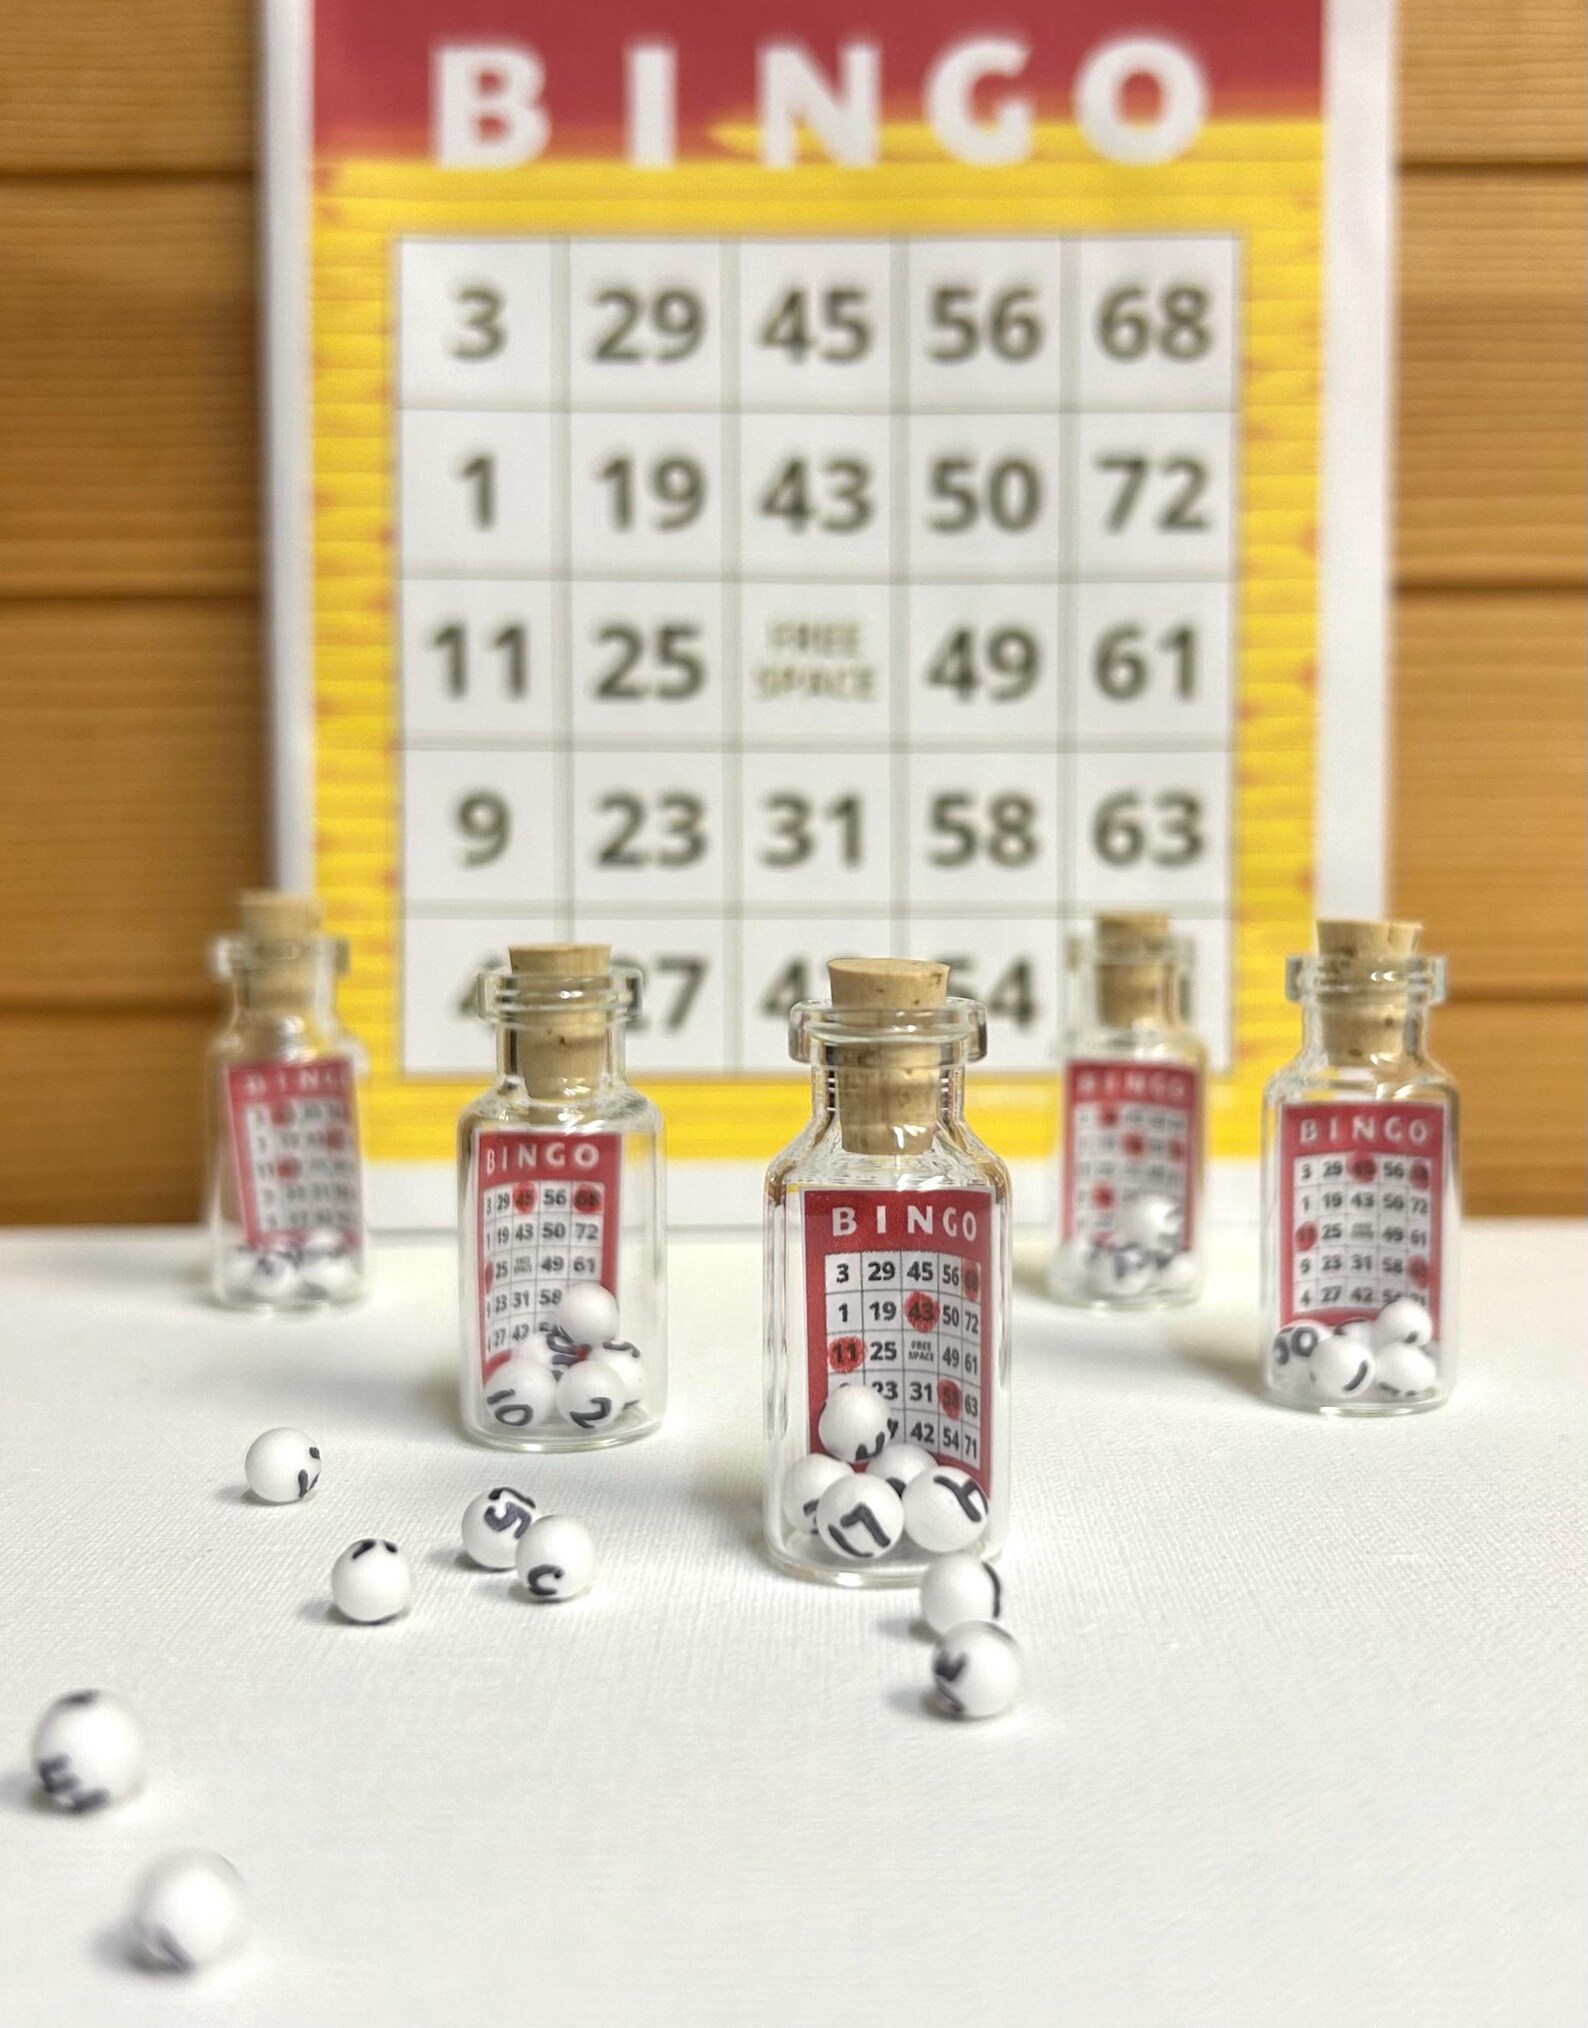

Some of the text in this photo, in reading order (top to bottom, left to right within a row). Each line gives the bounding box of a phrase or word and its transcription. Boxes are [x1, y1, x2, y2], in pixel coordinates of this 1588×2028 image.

[432, 37, 1210, 170] BINGO
[450, 279, 1214, 366] 3 29 45 56 68
[457, 449, 1211, 536] 1 19 43 50 72
[766, 618, 860, 659] FREE
[429, 619, 1198, 703] 11 25 49 61
[752, 664, 877, 702] SPACE
[452, 786, 1207, 870] 9 23 31 58 63
[1299, 1116, 1428, 1145] BINGO
[486, 1142, 600, 1175] BINGO
[1301, 1163, 1311, 1179] 3
[1383, 1162, 1404, 1178] 56
[497, 1192, 510, 1211] 29
[544, 1188, 566, 1206] 56
[1302, 1196, 1310, 1211] 1
[1321, 1193, 1342, 1209] 19
[1350, 1193, 1374, 1208] 43
[1410, 1197, 1428, 1214] 72
[496, 1226, 510, 1244] 19
[515, 1223, 534, 1240] 43
[542, 1223, 566, 1239] 50
[575, 1223, 599, 1239] 72
[832, 1204, 978, 1242] BINGO
[1321, 1223, 1342, 1239] 25
[1381, 1225, 1403, 1241] 49
[1410, 1229, 1427, 1245] 61
[495, 1261, 508, 1279] 25
[541, 1256, 564, 1273] 49
[573, 1257, 597, 1273] 61
[835, 1263, 850, 1284] 3
[867, 1261, 897, 1281] 29
[906, 1261, 934, 1282] 45
[942, 1264, 960, 1287] 56
[1300, 1258, 1310, 1273] 9
[1321, 1256, 1342, 1272] 23
[1351, 1255, 1371, 1271] 31
[1382, 1257, 1403, 1273] 58
[495, 1294, 508, 1312] 23
[513, 1291, 530, 1307] 31
[539, 1289, 562, 1305] 58
[1300, 1289, 1310, 1306] 4
[1321, 1286, 1341, 1302] 27
[1350, 1286, 1374, 1303] 42
[838, 1301, 979, 1334] 1 19 43 50 72
[495, 1328, 507, 1347] 27
[512, 1322, 530, 1341] 42
[910, 1340, 932, 1351] FREE
[833, 1341, 978, 1375] 11 25 49 61
[909, 1381, 933, 1402] 31
[964, 1394, 979, 1418] 63
[910, 1422, 935, 1445] 42
[942, 1426, 960, 1451] 54
[964, 1434, 978, 1460] 71
